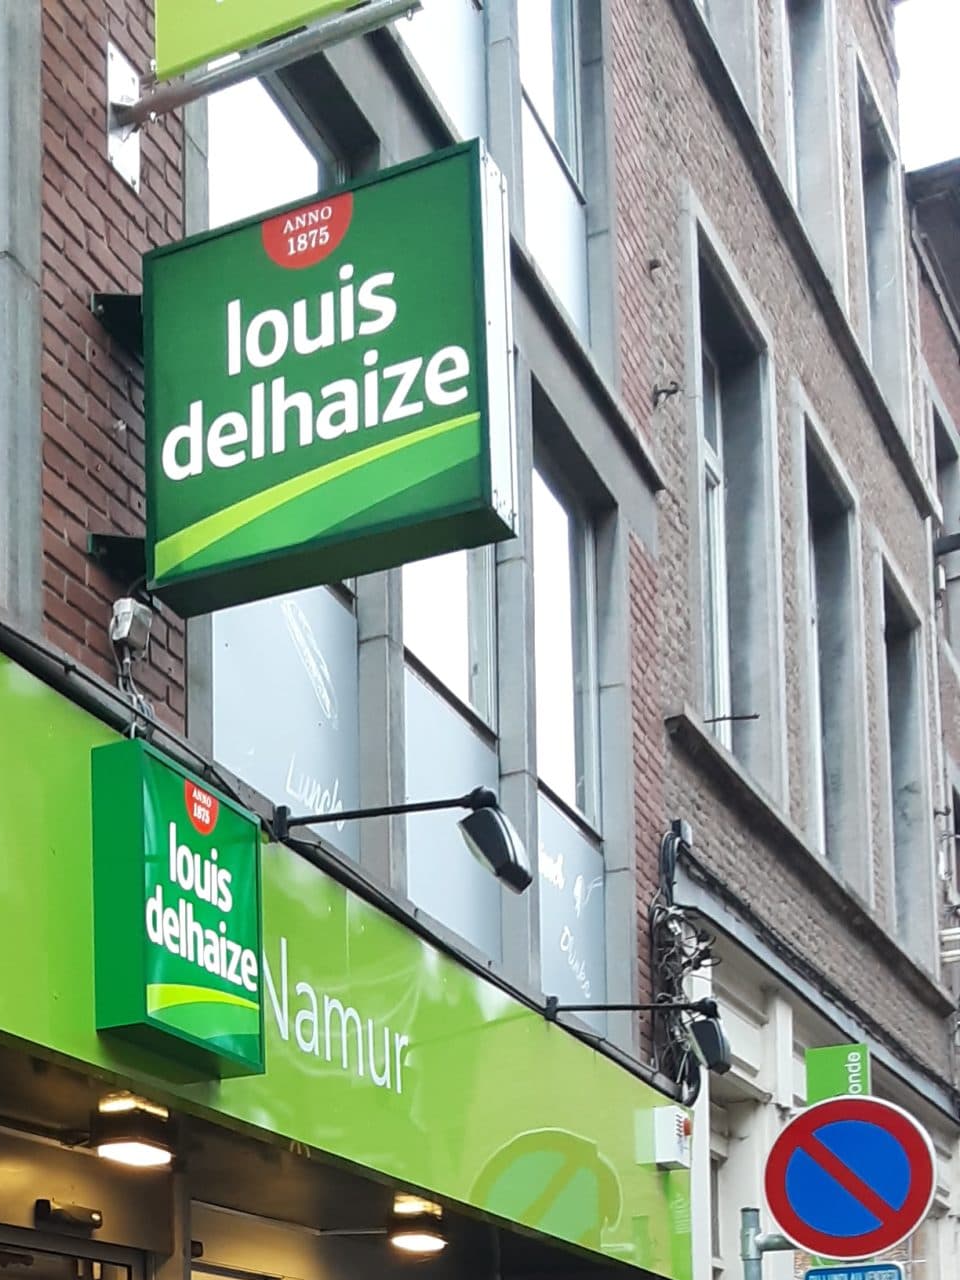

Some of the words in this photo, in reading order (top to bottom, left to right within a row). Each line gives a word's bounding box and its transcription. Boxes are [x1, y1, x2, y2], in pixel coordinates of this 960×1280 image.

[283, 206, 333, 233] ANNO
[287, 226, 330, 256] 1875
[226, 263, 397, 376] louis
[161, 344, 470, 481] delhaize
[191, 788, 212, 807] ANNO
[193, 802, 210, 826] 1875
[169, 822, 232, 912] louis
[145, 884, 258, 991] delhaize
[263, 937, 409, 1094] Namur
[845, 1052, 861, 1094] onde
